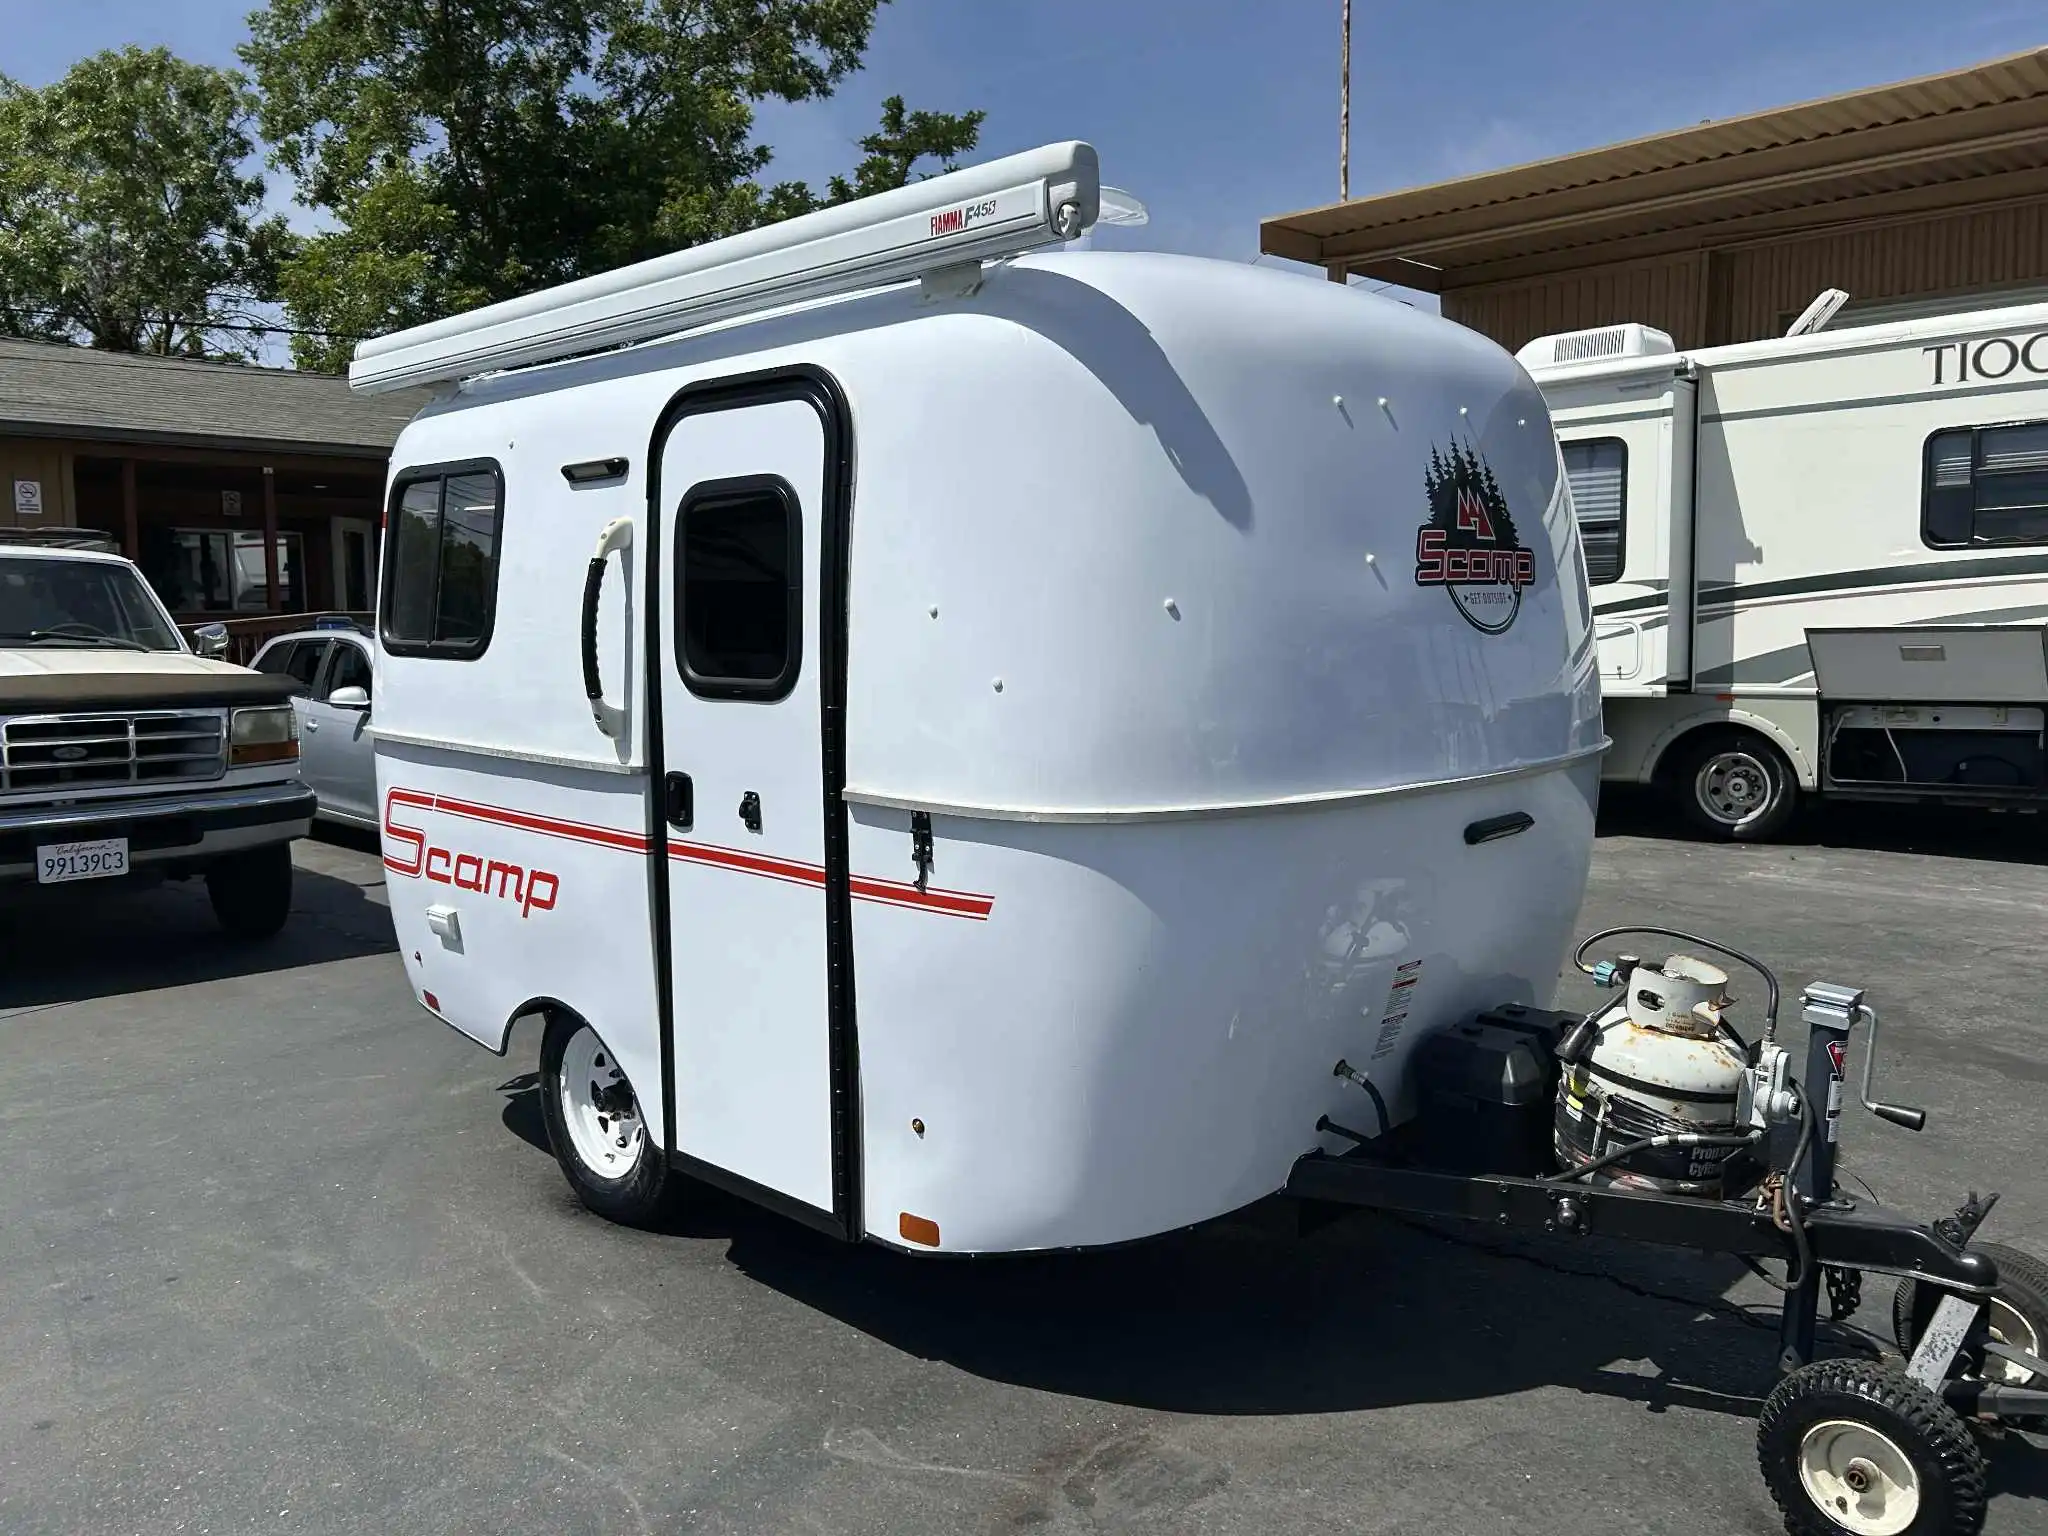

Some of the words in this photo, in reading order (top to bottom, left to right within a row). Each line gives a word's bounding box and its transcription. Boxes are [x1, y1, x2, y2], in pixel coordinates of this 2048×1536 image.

[931, 209, 963, 236] FIAMMA
[1417, 529, 1534, 592] Scamp
[45, 852, 123, 877] 99139C3
[384, 787, 560, 918] Scamp
